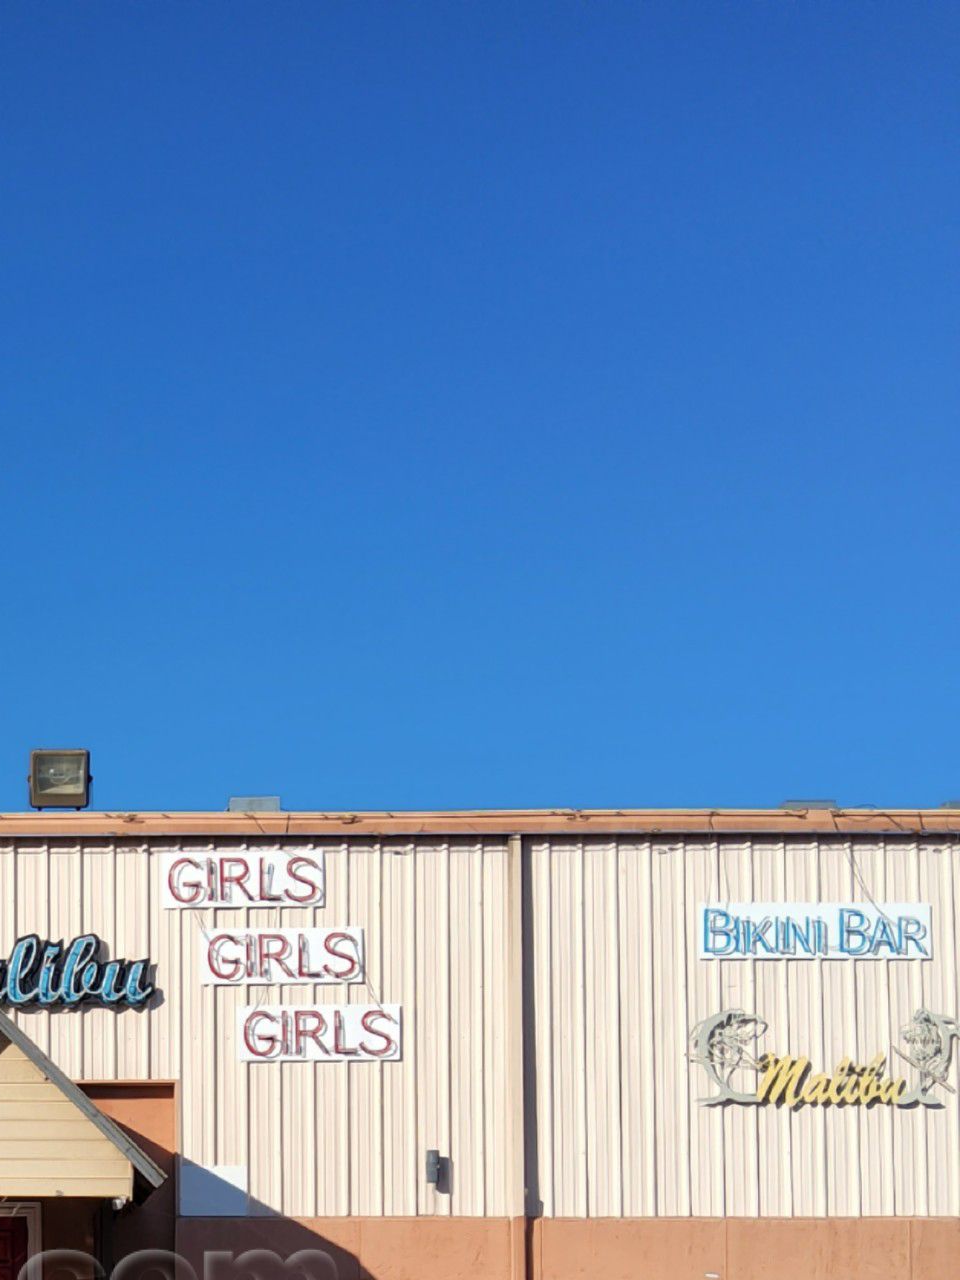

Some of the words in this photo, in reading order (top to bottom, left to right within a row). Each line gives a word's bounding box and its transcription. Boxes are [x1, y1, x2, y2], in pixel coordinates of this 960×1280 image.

[168, 856, 324, 904] GIRLS
[208, 932, 362, 980] GIRLS
[703, 908, 828, 956] BIKINI
[838, 908, 929, 956] BAR
[244, 1010, 398, 1058] GIRLS
[756, 1051, 906, 1109] Malibu
